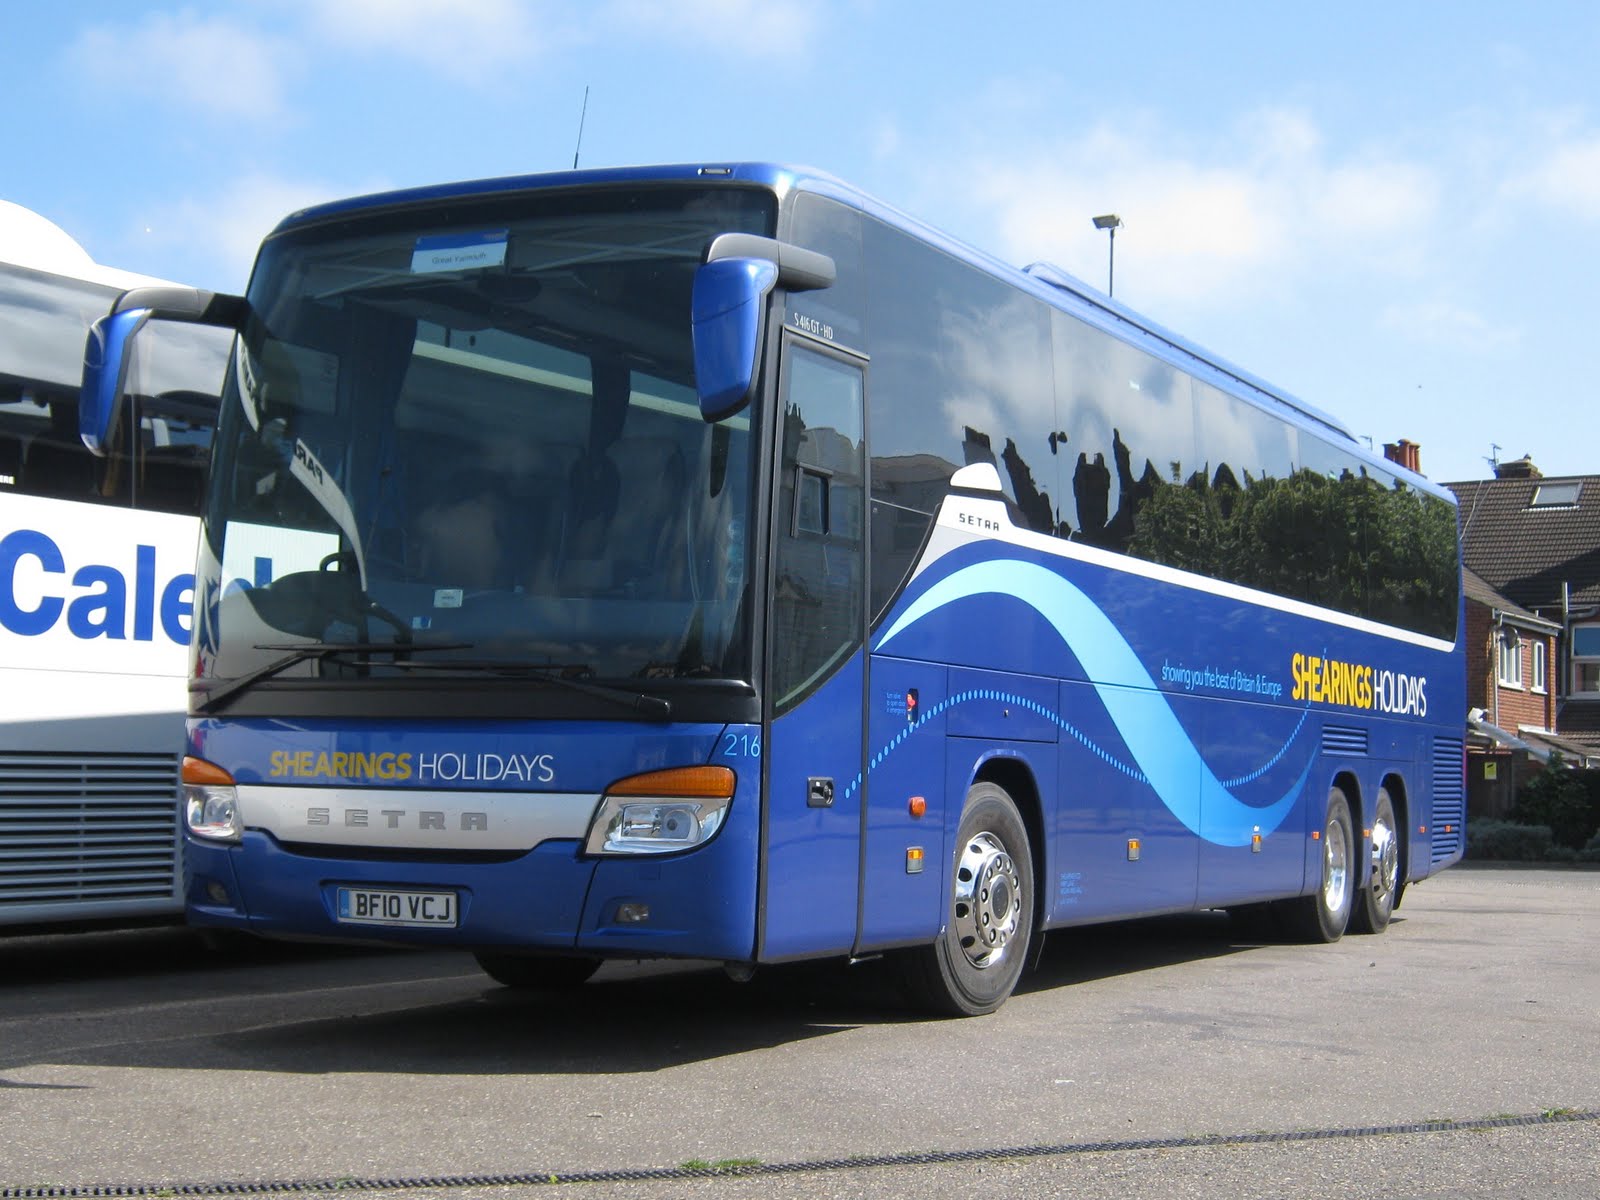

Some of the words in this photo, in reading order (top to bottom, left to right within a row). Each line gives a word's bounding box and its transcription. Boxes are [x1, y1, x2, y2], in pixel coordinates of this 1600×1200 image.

[794, 312, 799, 327] S
[799, 315, 811, 331] 416
[959, 512, 1000, 532] SETRA
[1161, 658, 1191, 690] showing
[1190, 670, 1204, 690] you
[1204, 665, 1215, 687] the
[1215, 667, 1230, 689] best
[1230, 669, 1238, 690] of
[1237, 671, 1256, 693] Britain
[1256, 673, 1261, 694] &
[1261, 675, 1282, 701] Europe
[1291, 652, 1373, 710] SHEARINGS
[1373, 669, 1427, 718] HOLIDAYS
[724, 733, 760, 758] 216
[269, 751, 412, 780] SHEARINGS
[418, 753, 554, 782] HOLIDAYS
[306, 807, 489, 831] SETRA
[355, 893, 401, 918] BF10
[408, 896, 450, 921] VCJ
